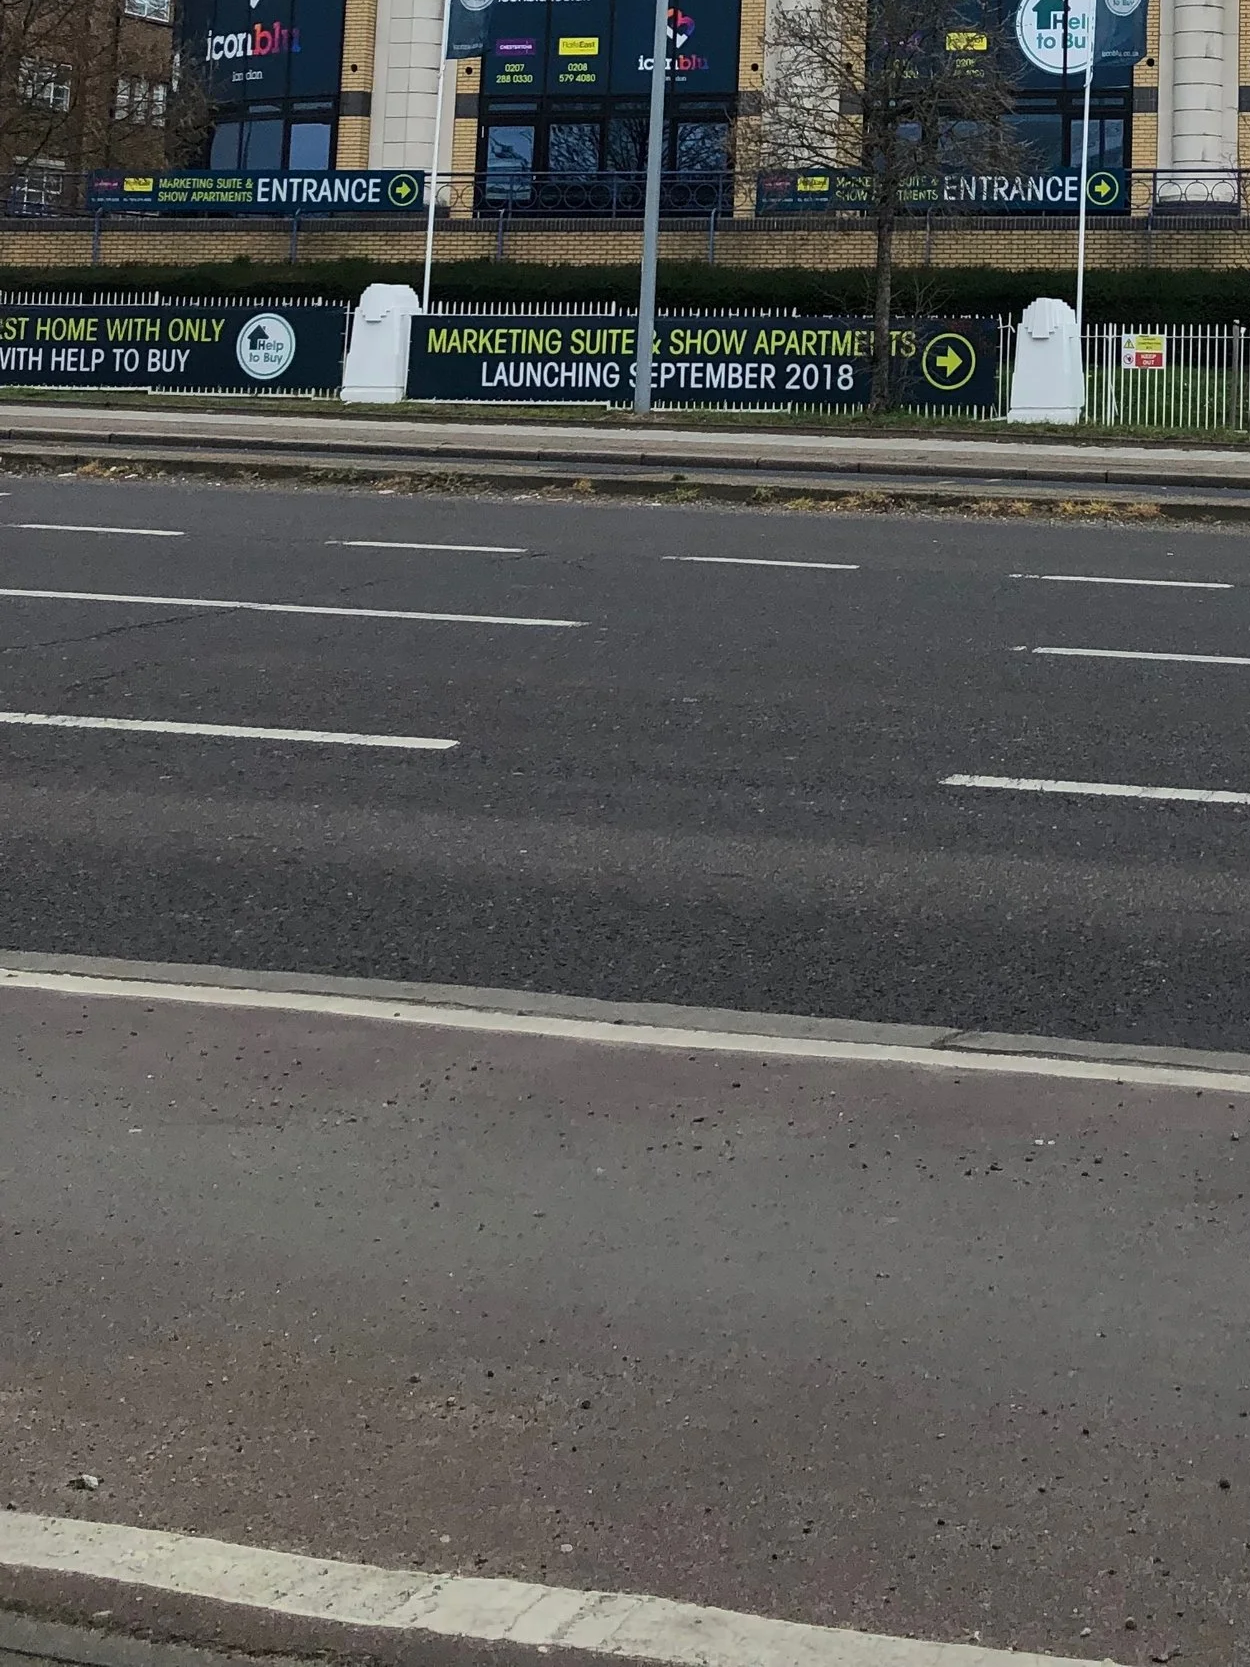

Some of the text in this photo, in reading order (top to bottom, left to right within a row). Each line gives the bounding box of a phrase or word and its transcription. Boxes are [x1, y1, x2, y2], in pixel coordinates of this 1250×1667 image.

[1037, 33, 1056, 49] to
[505, 63, 525, 72] 0207
[568, 63, 588, 72] 0208
[496, 75, 533, 83] 288 0330
[559, 74, 574, 82] 579
[158, 178, 213, 189] MARKETING
[216, 178, 242, 189] SUITE
[245, 178, 254, 189] &
[256, 177, 382, 203] ENTRANCE
[943, 176, 1079, 202] ENTRANCE
[157, 191, 187, 202] SHOW
[190, 191, 253, 202] APARTMENTS
[36, 317, 99, 341] HOME
[106, 318, 167, 342] WITH
[168, 318, 226, 343] ONLY
[258, 339, 284, 353] Help
[427, 328, 563, 354] MARKETING
[570, 329, 635, 355] SUITE
[669, 329, 748, 356] SHOW
[51, 348, 105, 372] HELP
[113, 348, 139, 372] TO
[147, 348, 191, 372] BUY
[249, 352, 283, 365] to Buy
[481, 361, 621, 387] LAUNCHING
[785, 363, 854, 391] 2018
